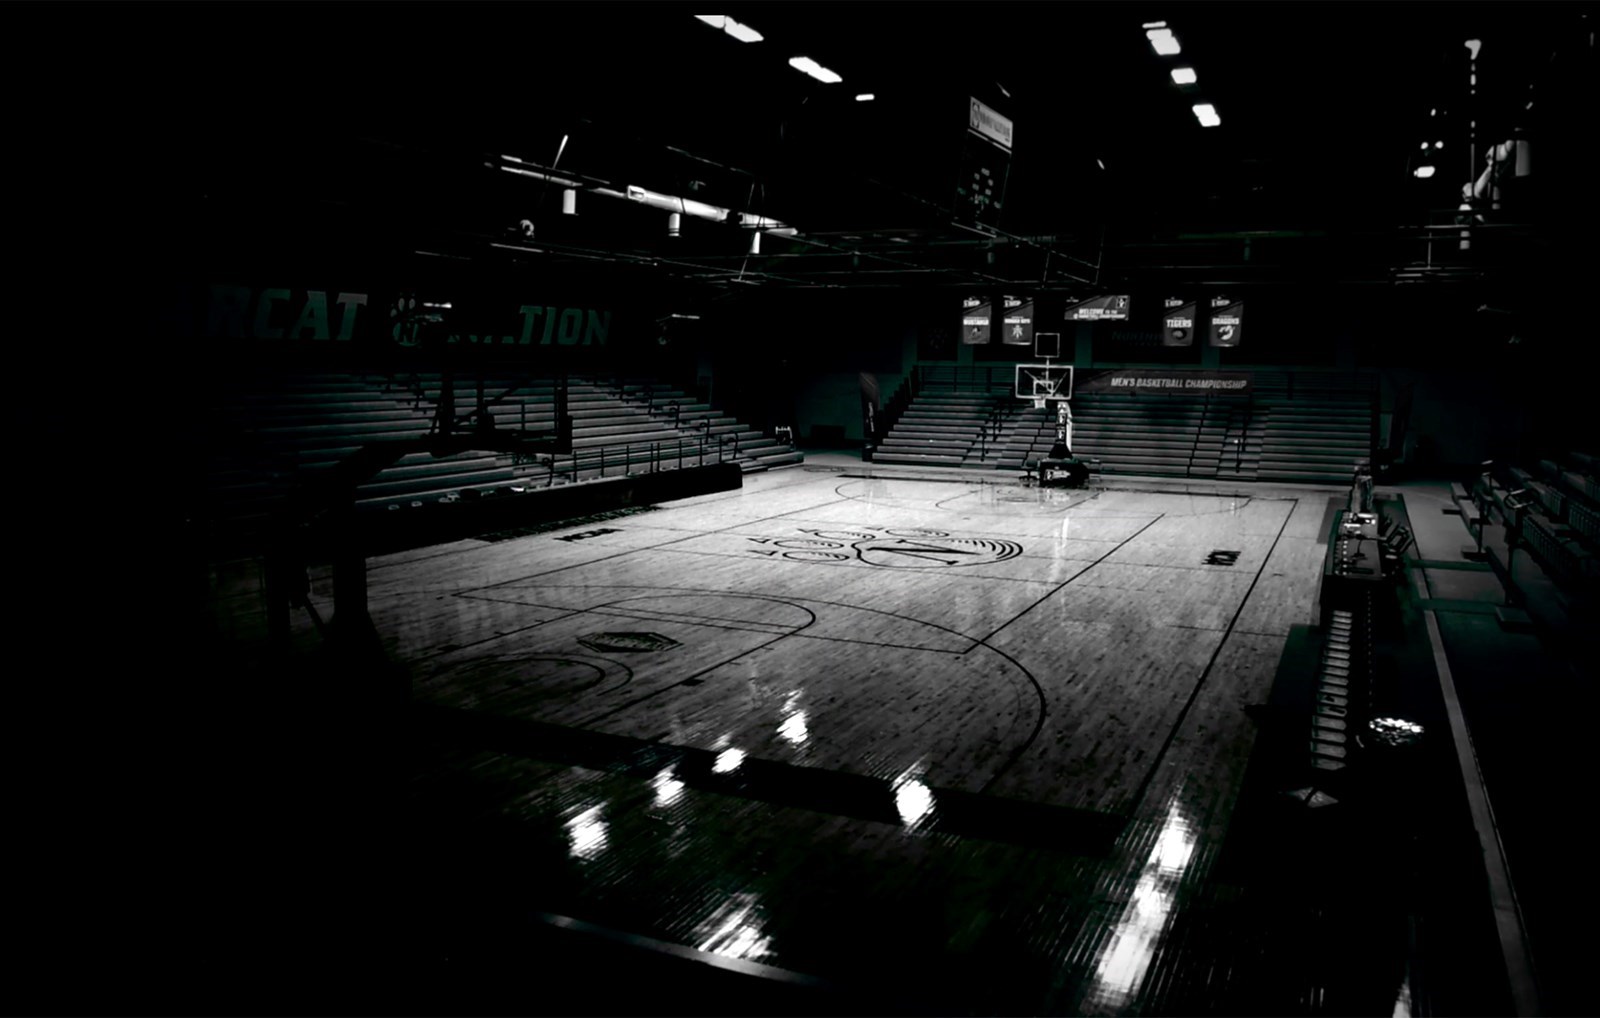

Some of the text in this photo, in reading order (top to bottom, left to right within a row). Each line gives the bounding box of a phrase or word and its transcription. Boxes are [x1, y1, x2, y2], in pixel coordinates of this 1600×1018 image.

[1166, 319, 1192, 328] TIGERS
[1110, 377, 1248, 390] MEN'S BASKETBALL CHAMPIONSHIP
